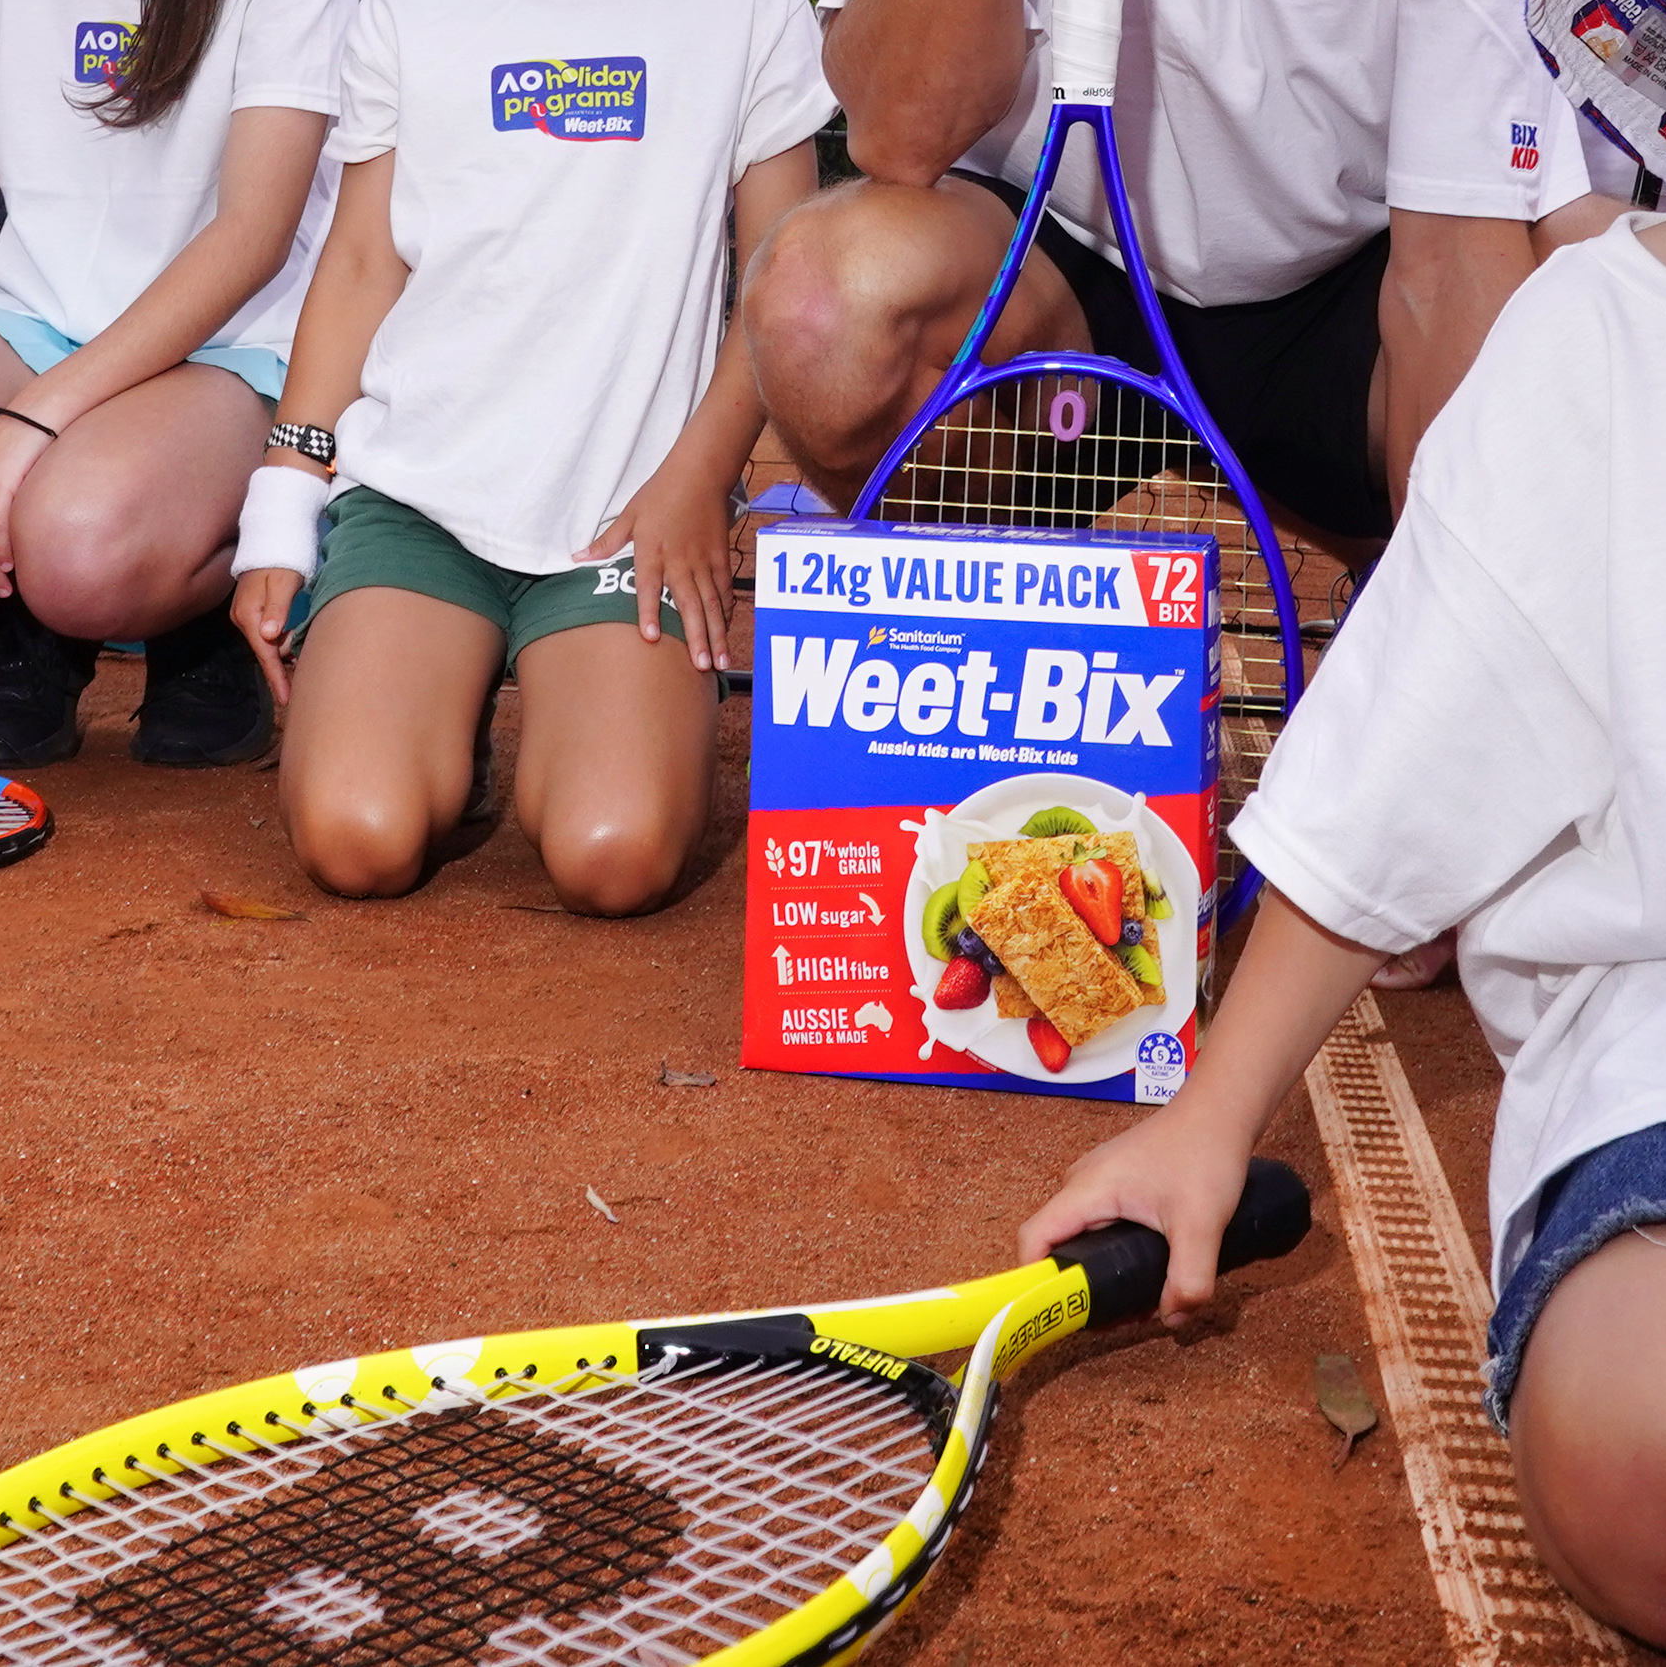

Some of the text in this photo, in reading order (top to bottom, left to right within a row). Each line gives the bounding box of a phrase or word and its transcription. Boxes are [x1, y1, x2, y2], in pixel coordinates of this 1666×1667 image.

[1622, 54, 1644, 74] MADE
[564, 116, 634, 134] Weet-Bix
[1510, 121, 1539, 148] BIX
[1510, 146, 1540, 171] KID
[772, 550, 1122, 611] 1.2kg VALUE PACK
[1147, 556, 1199, 603] 72
[1158, 602, 1197, 625] BIX
[770, 634, 1185, 748] Weet-Bix
[867, 740, 1079, 766] Aussie kids are Weet-Bix kids
[836, 841, 880, 859] whole
[838, 858, 882, 876] GRAIN
[772, 901, 866, 929] LOW sugar
[796, 956, 890, 982] HIGH fibre
[782, 1007, 850, 1031] AUSSIE
[782, 1029, 869, 1046] OWNED & MADE
[1157, 1049, 1165, 1062] 5
[1007, 1300, 1064, 1365] SERIES
[1067, 1289, 1089, 1319] 21
[809, 1336, 911, 1381] BUFFALO
